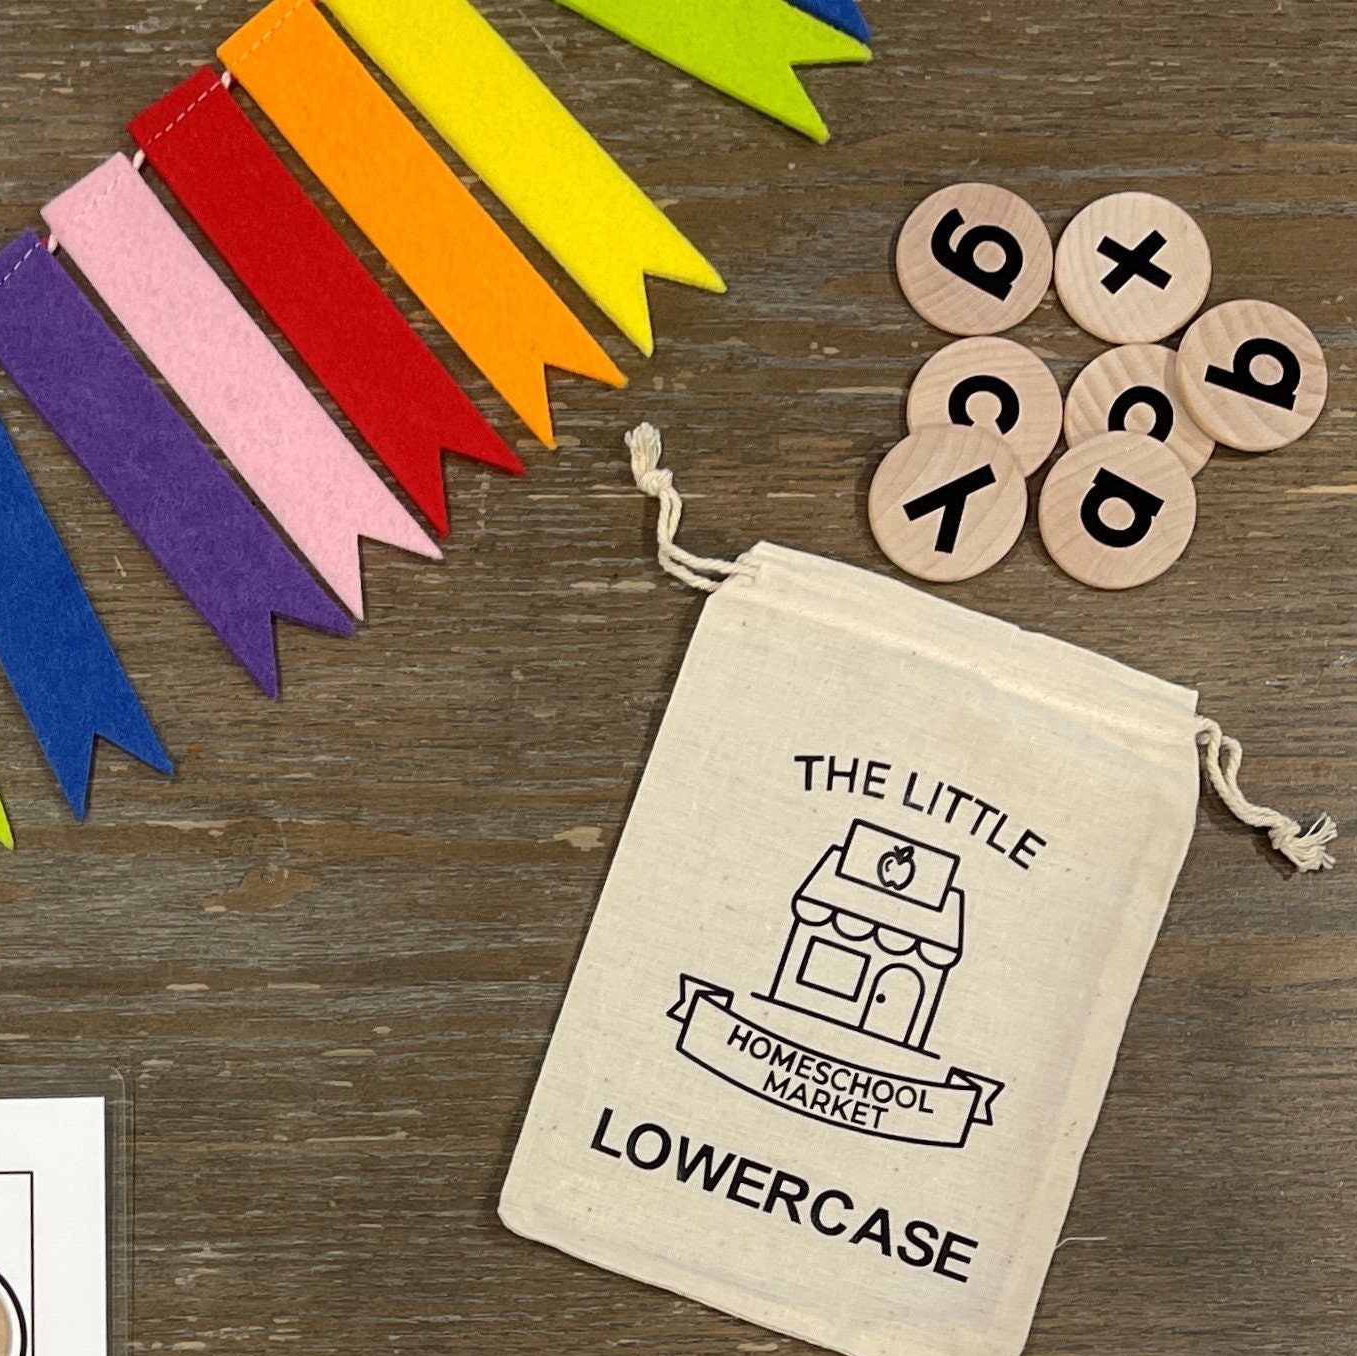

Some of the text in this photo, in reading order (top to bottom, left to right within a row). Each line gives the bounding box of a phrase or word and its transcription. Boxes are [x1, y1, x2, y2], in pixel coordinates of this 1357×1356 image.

[930, 208, 1024, 302] g
[1097, 230, 1171, 294] x
[949, 375, 1019, 434] c
[903, 464, 996, 553] y
[1081, 468, 1164, 548] a
[794, 754, 1047, 871] THE LITTLE
[727, 1023, 934, 1115] HOMESCHOOL
[763, 1070, 889, 1131] MARKET
[589, 1106, 980, 1284] LOWERCASE
